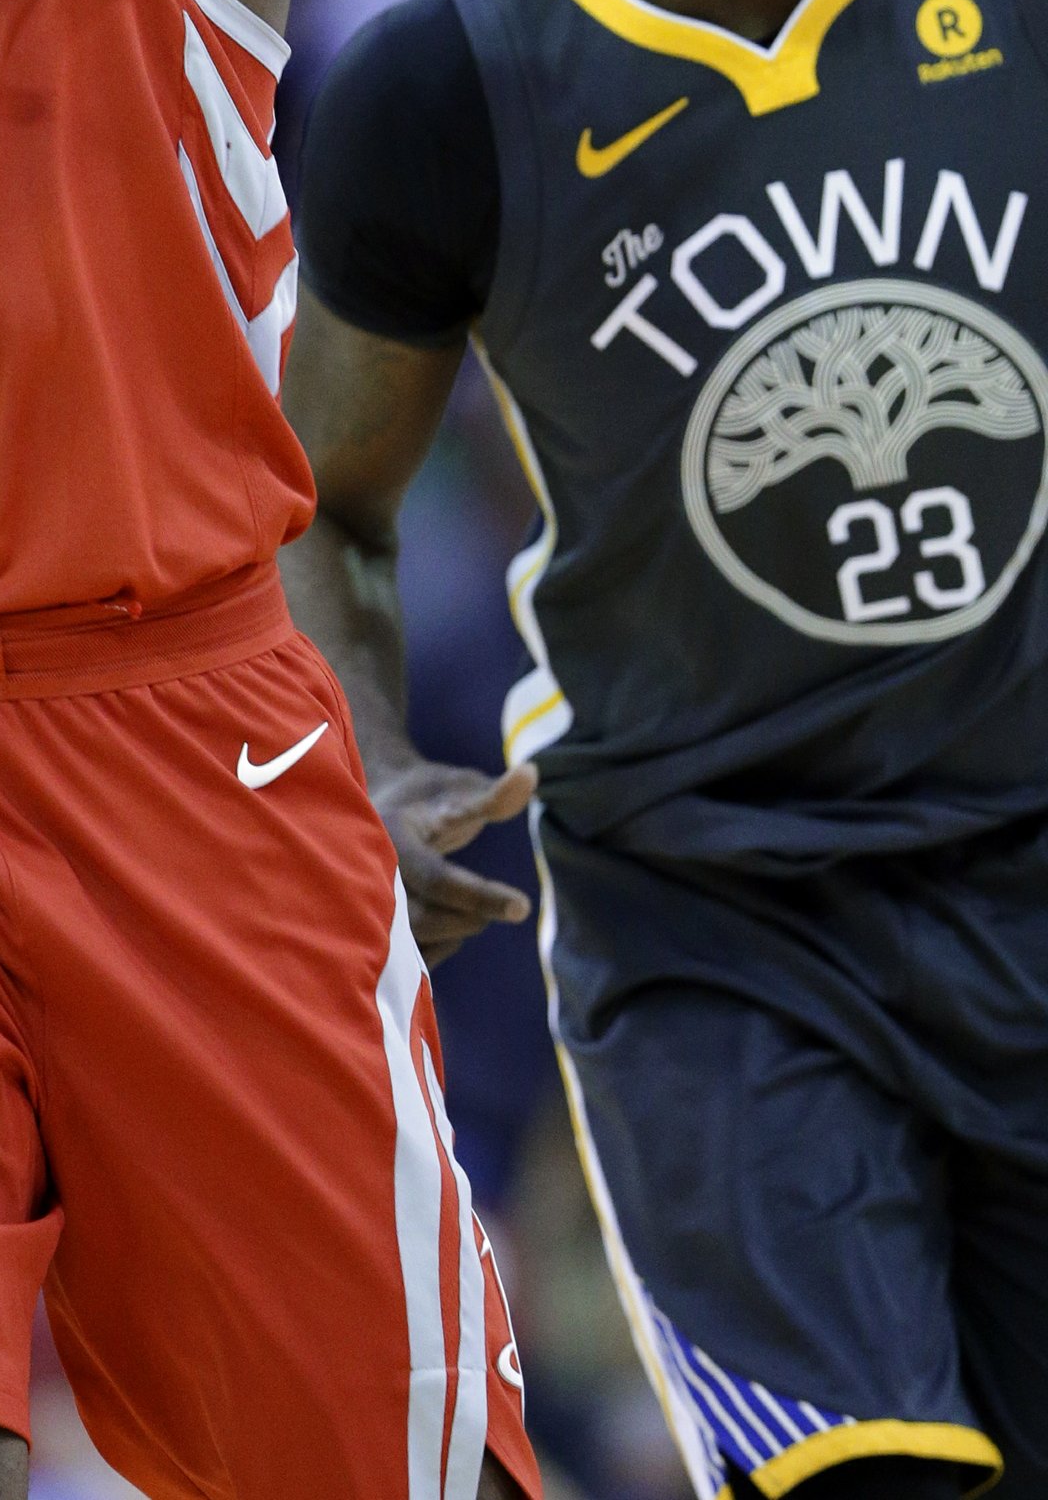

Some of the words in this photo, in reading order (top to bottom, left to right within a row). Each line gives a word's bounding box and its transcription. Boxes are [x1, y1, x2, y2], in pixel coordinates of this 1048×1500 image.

[937, 7, 966, 42] R
[590, 157, 1029, 378] TOWN
[601, 222, 665, 288] The
[827, 486, 986, 623] 23
